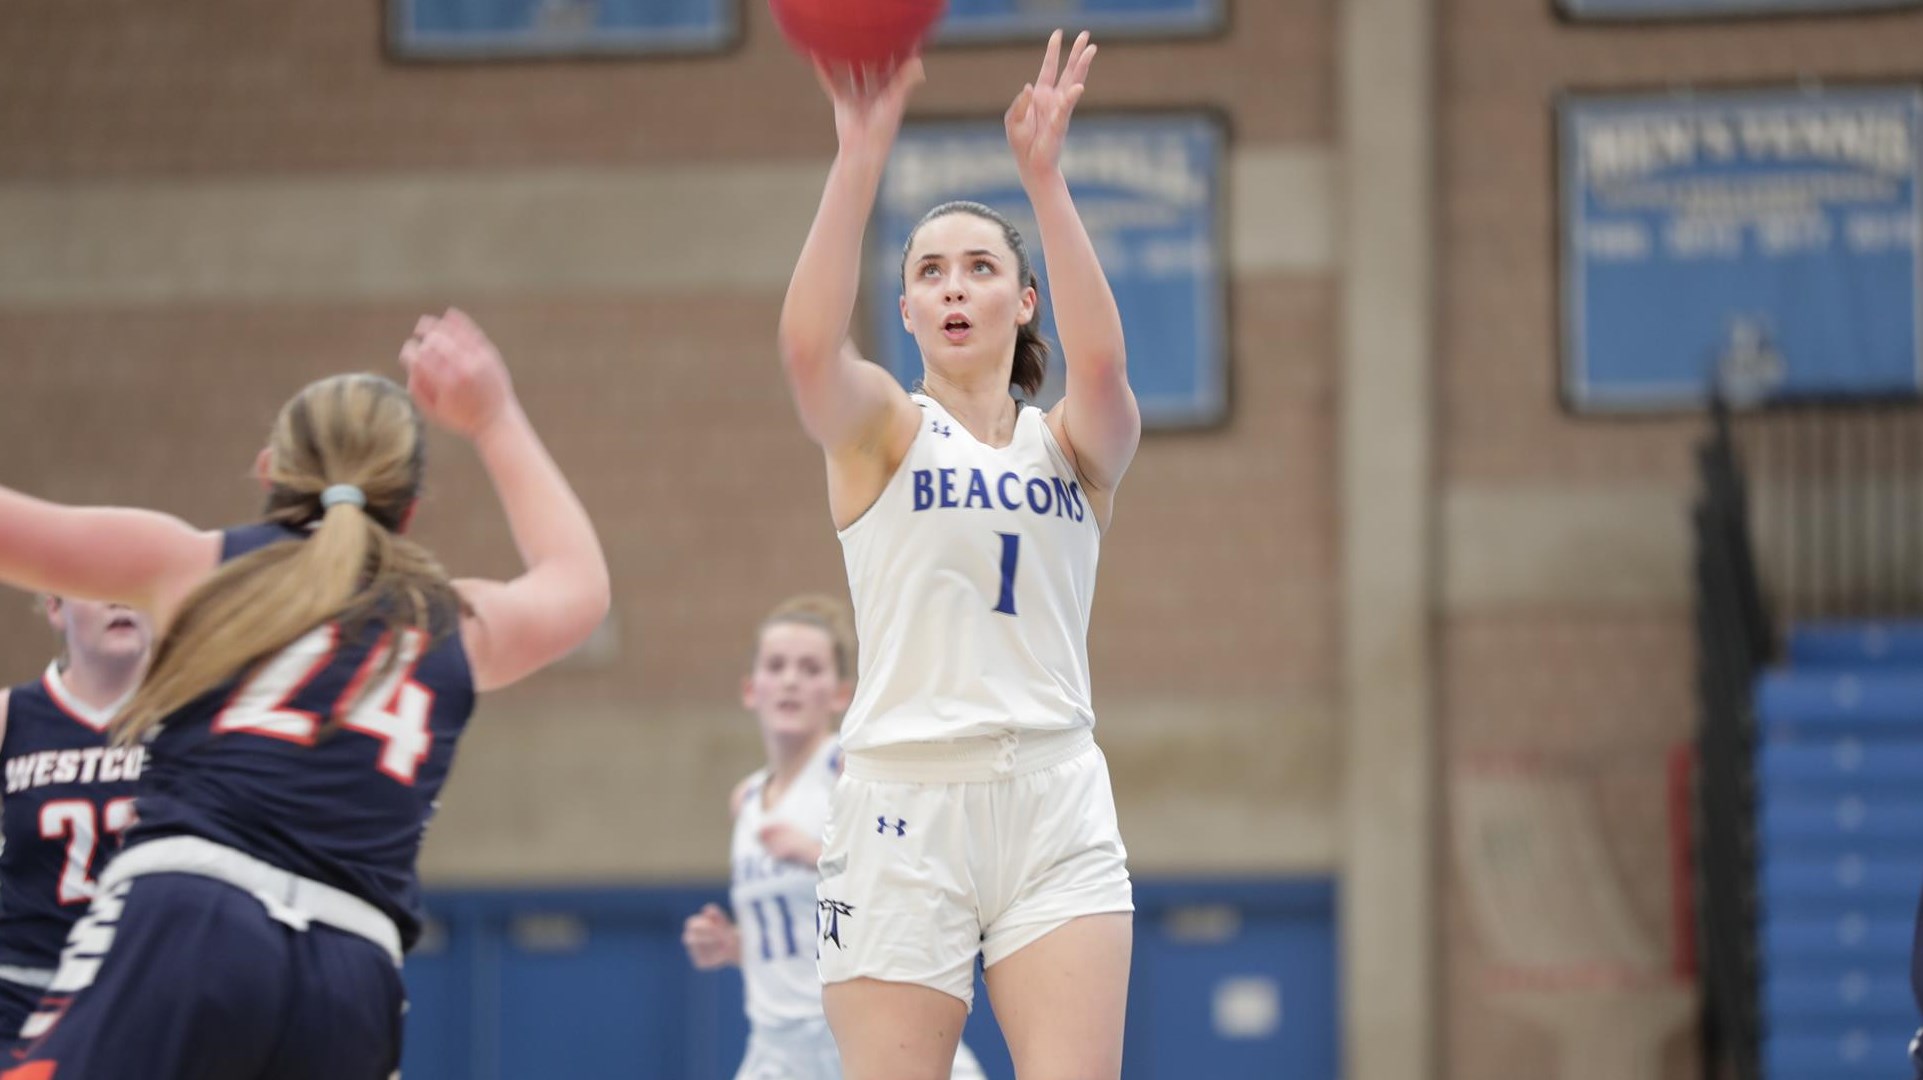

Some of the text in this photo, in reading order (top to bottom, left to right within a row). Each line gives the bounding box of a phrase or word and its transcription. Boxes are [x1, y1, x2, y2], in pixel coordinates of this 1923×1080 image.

[912, 468, 1084, 522] BEACONS
[993, 530, 1020, 616] 1
[210, 619, 436, 786] 24
[750, 893, 799, 961] 11
